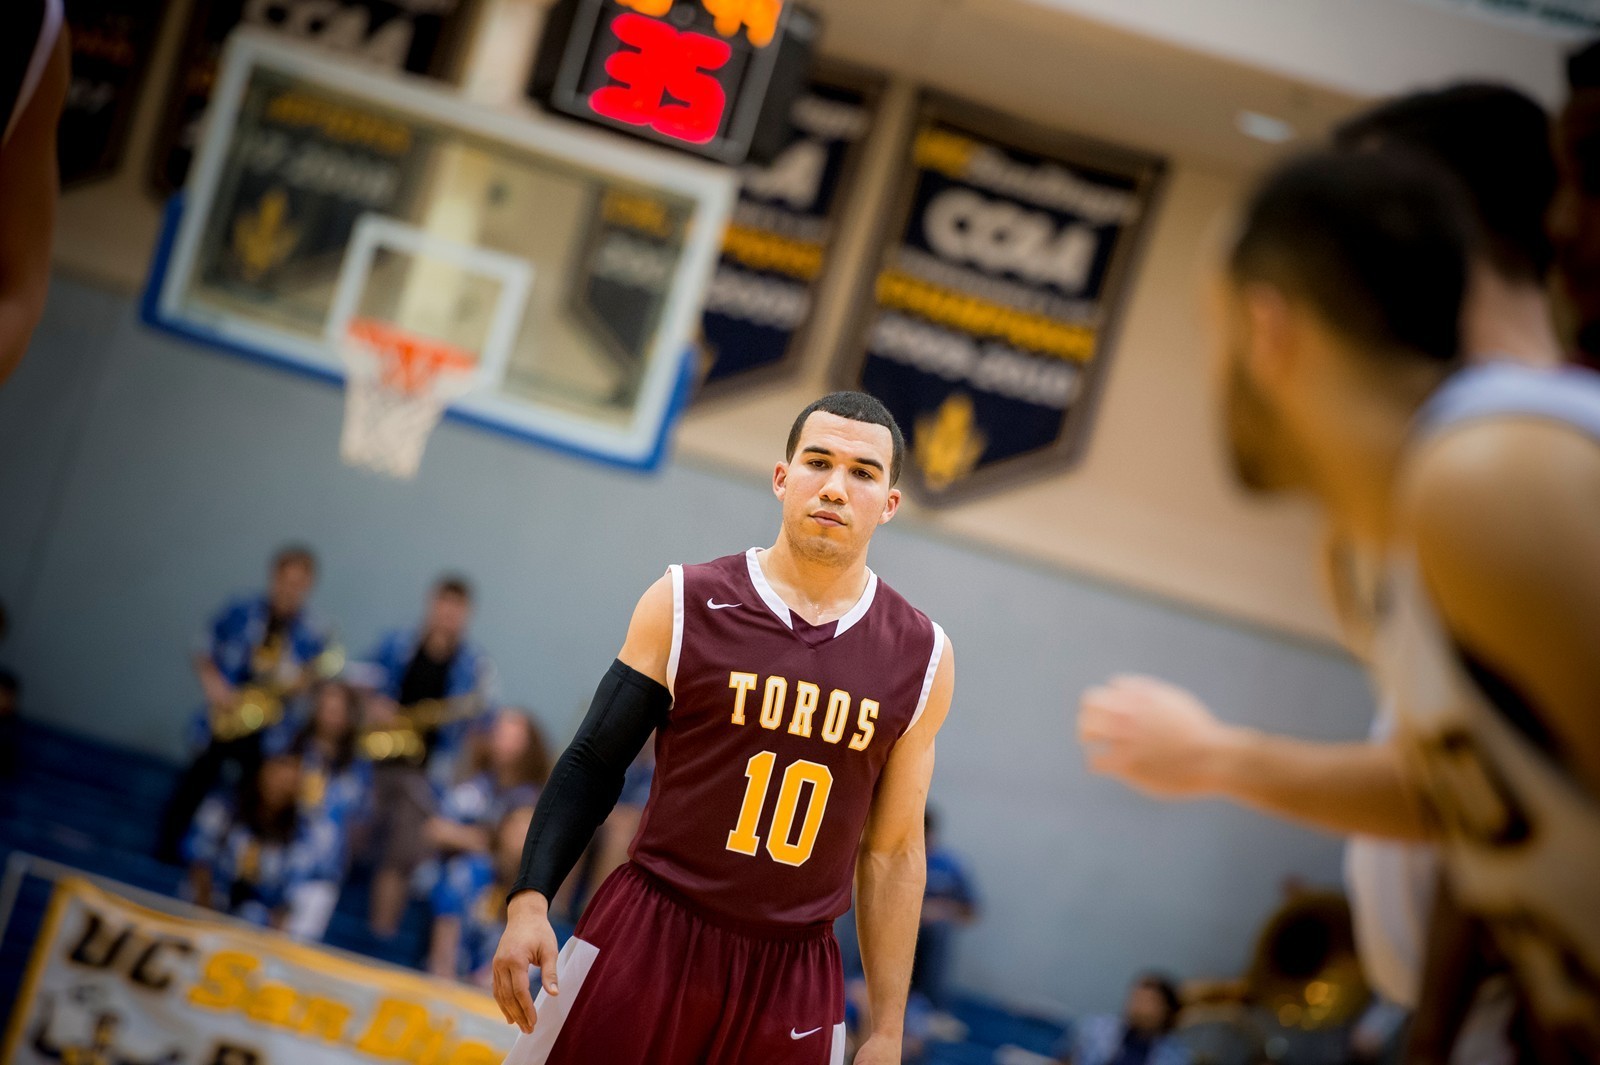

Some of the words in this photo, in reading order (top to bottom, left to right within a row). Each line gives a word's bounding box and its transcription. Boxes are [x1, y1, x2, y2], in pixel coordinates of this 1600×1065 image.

[590, 13, 732, 144] 35
[728, 671, 880, 751] TOROS
[725, 750, 834, 867] 10
[68, 908, 196, 991] UC
[188, 950, 350, 1047] San
